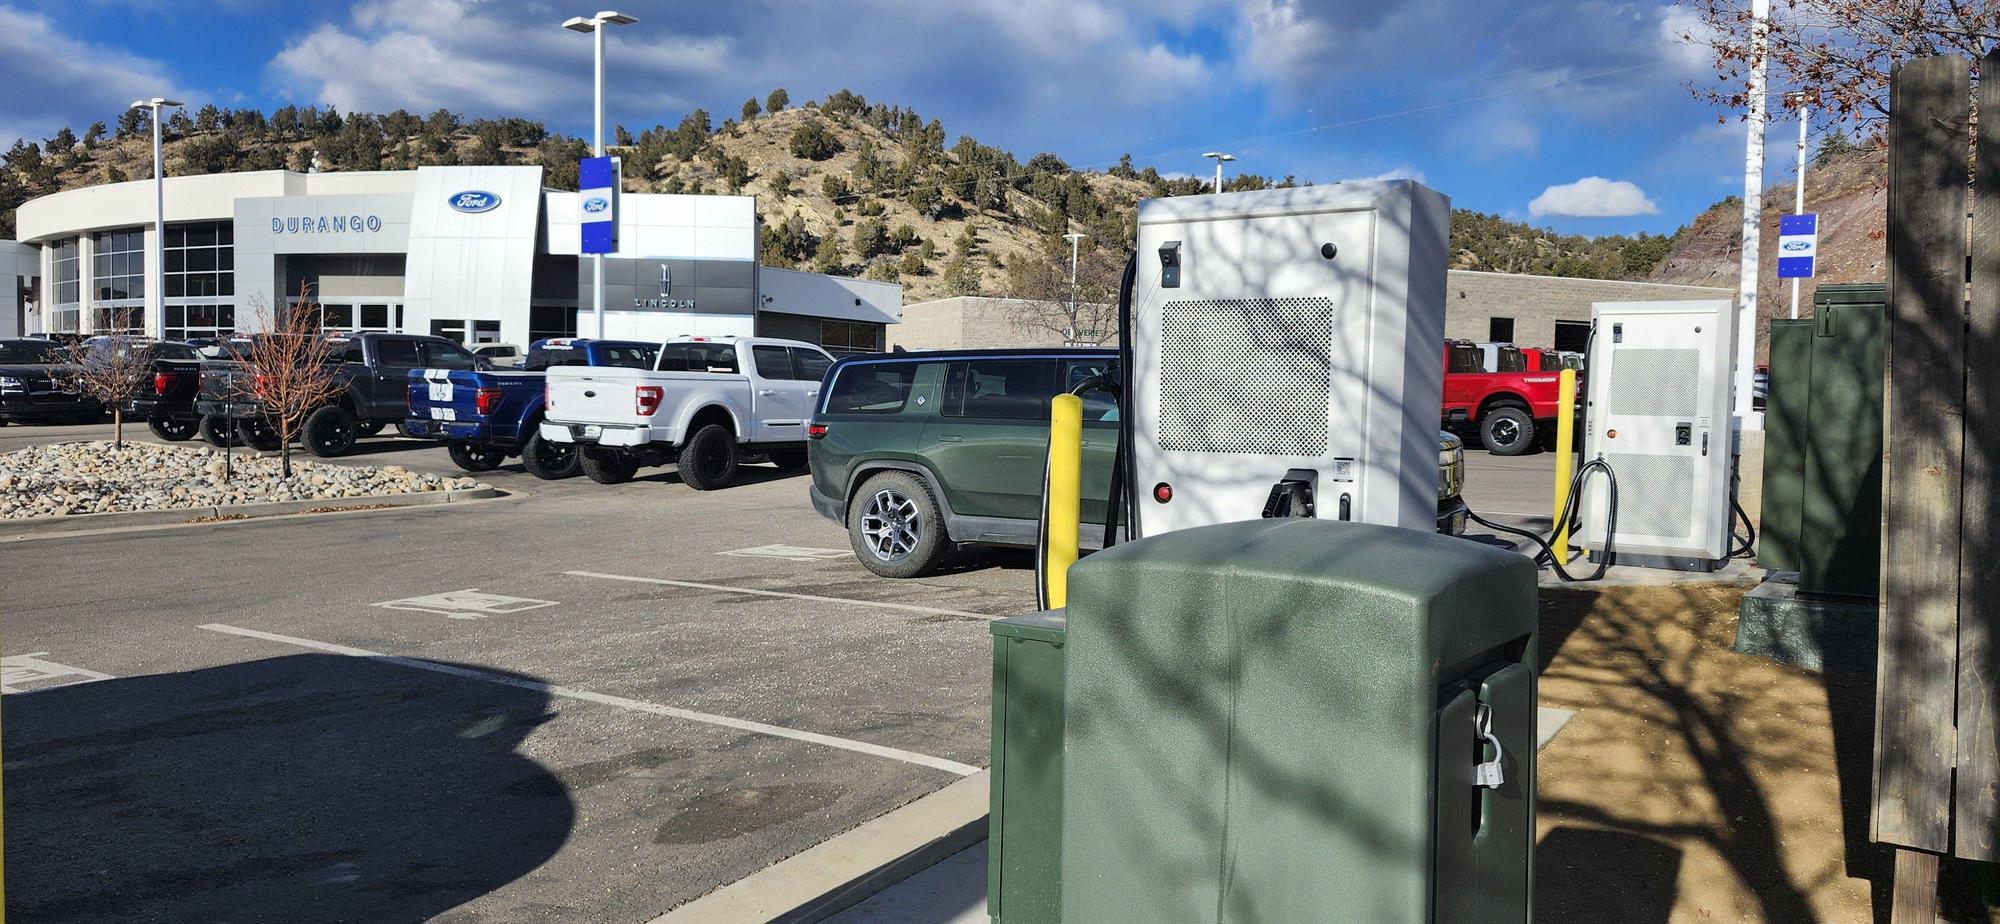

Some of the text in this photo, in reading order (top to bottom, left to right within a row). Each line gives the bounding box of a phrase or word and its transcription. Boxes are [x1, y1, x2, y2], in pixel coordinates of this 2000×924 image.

[457, 193, 488, 207] Ford
[587, 199, 605, 211] Ford
[271, 215, 382, 233] DURANGO
[634, 298, 696, 308] LINCOLN
